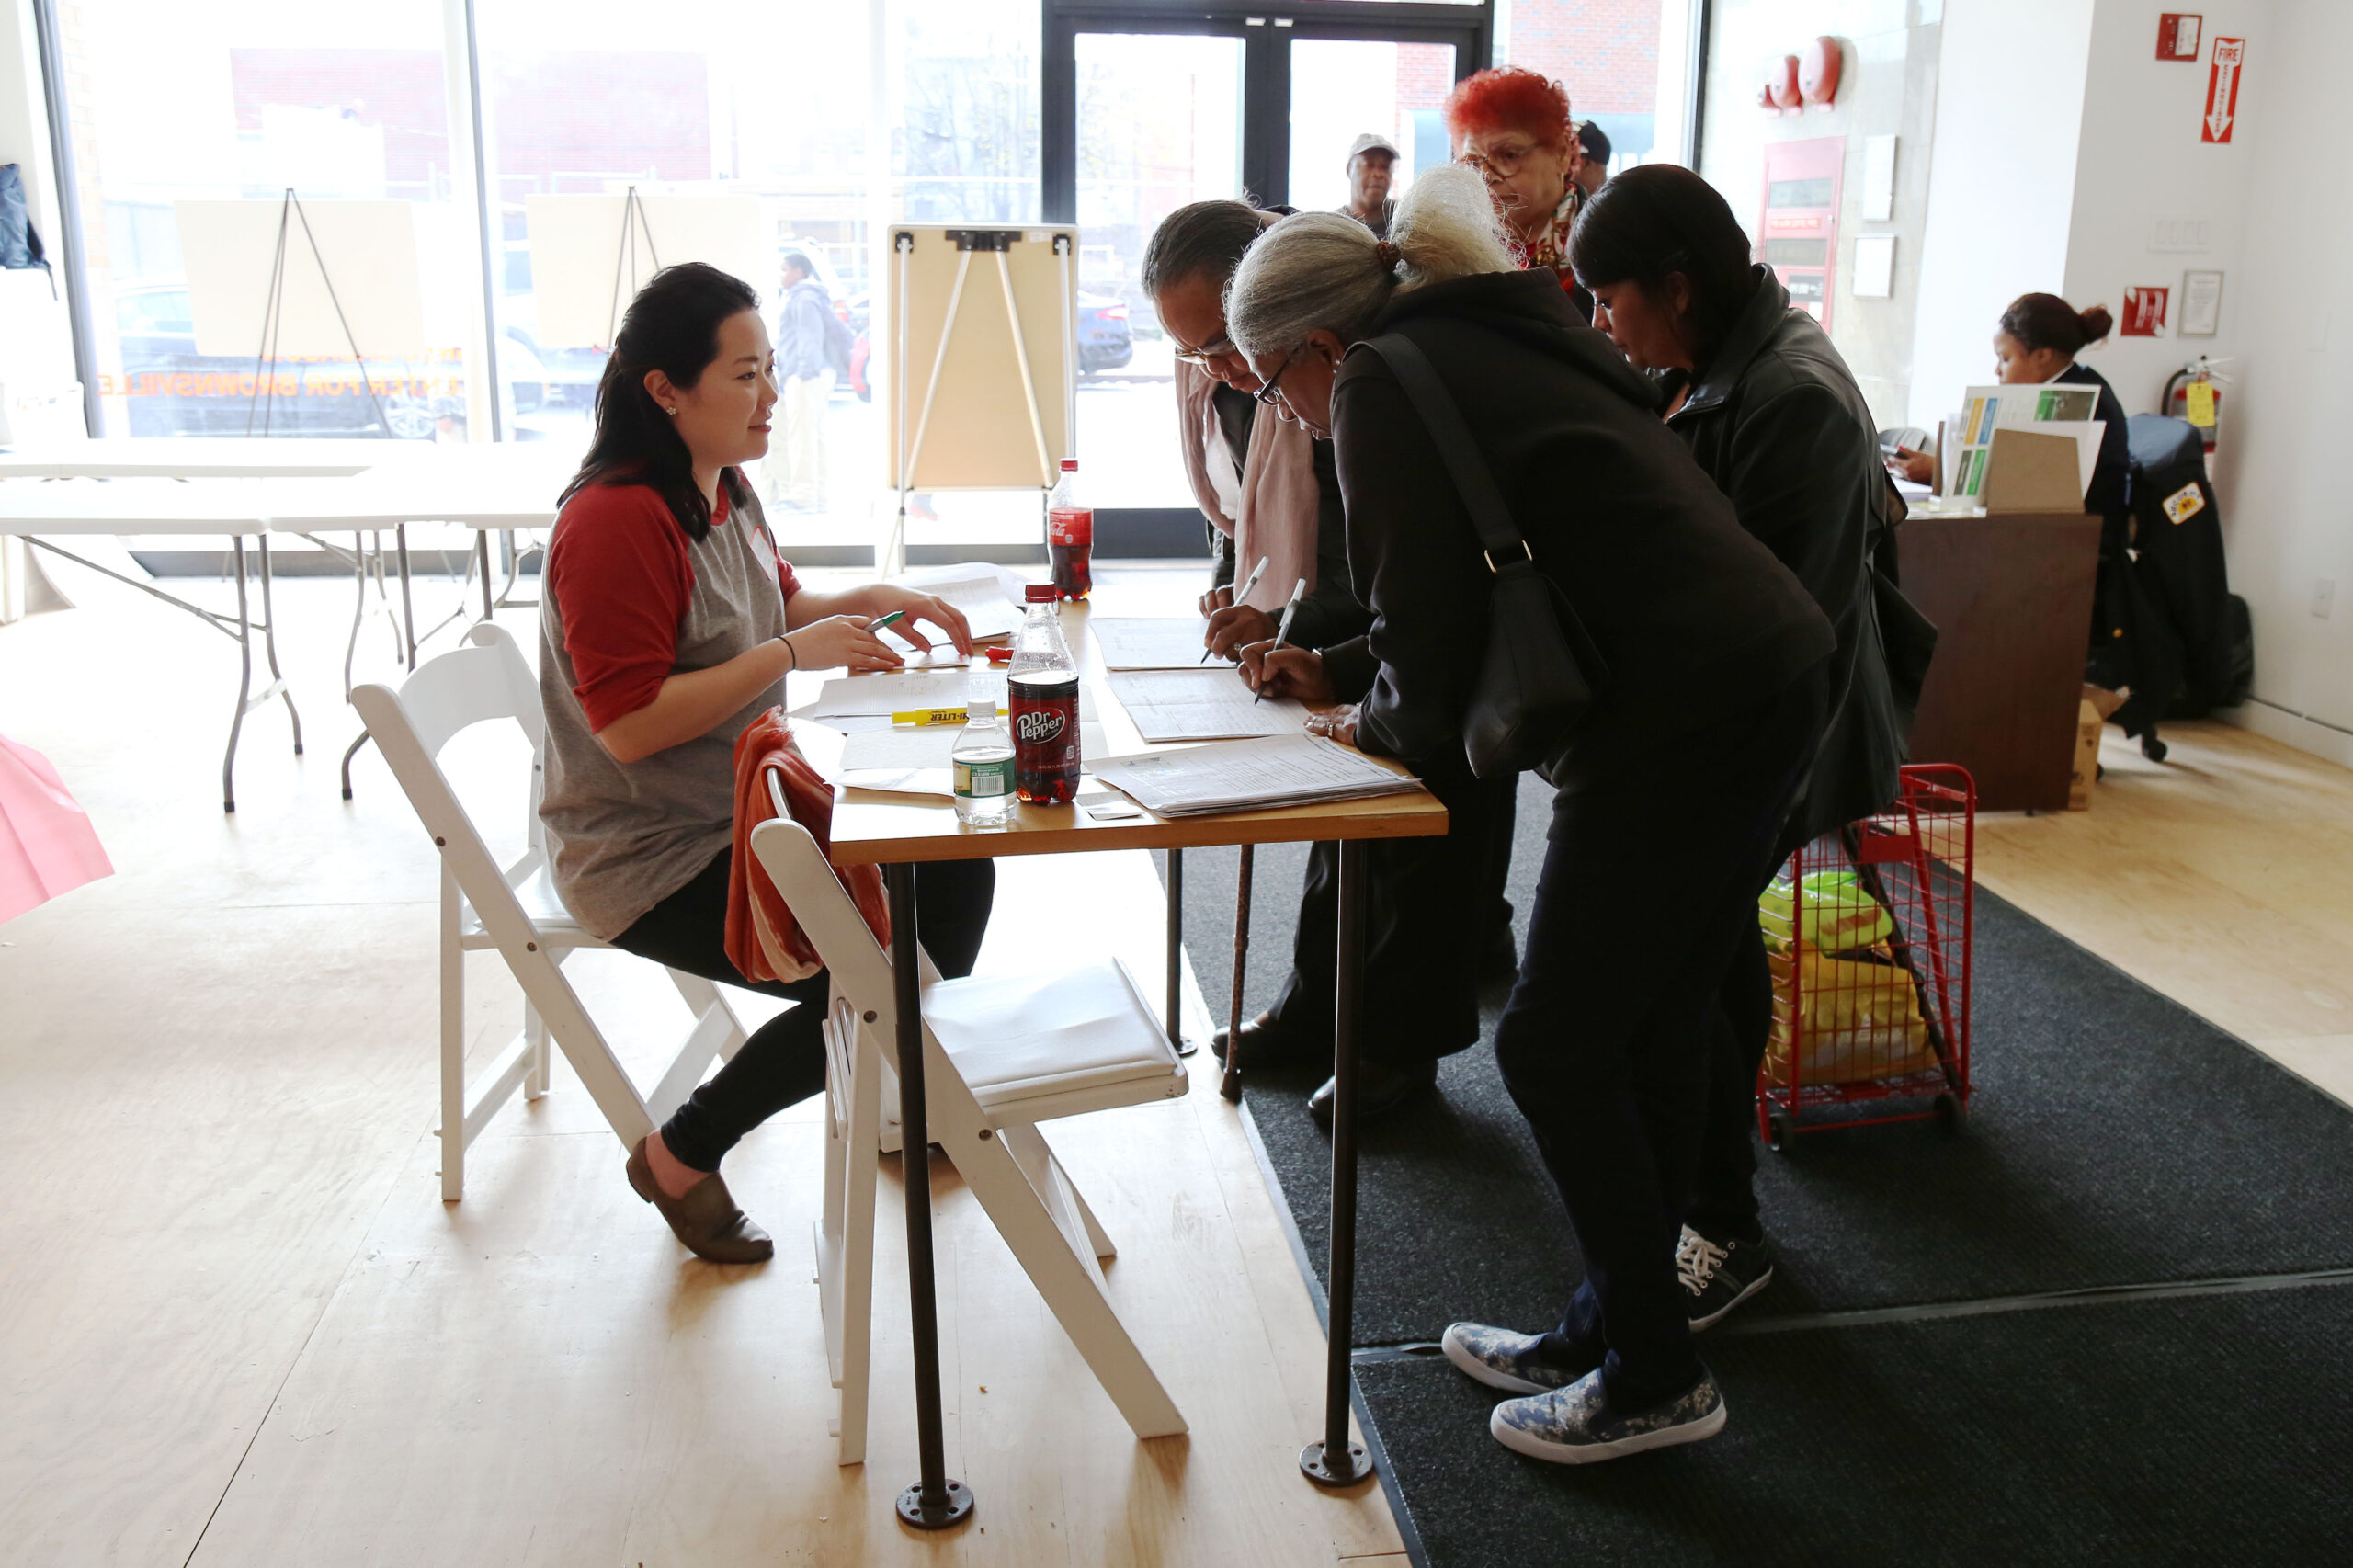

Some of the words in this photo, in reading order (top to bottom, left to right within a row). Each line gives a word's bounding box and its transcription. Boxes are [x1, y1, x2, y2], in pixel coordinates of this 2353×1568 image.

[2218, 47, 2240, 62] FIRE
[1017, 714, 1062, 740] Pepper
[1031, 711, 1051, 727] Dr
